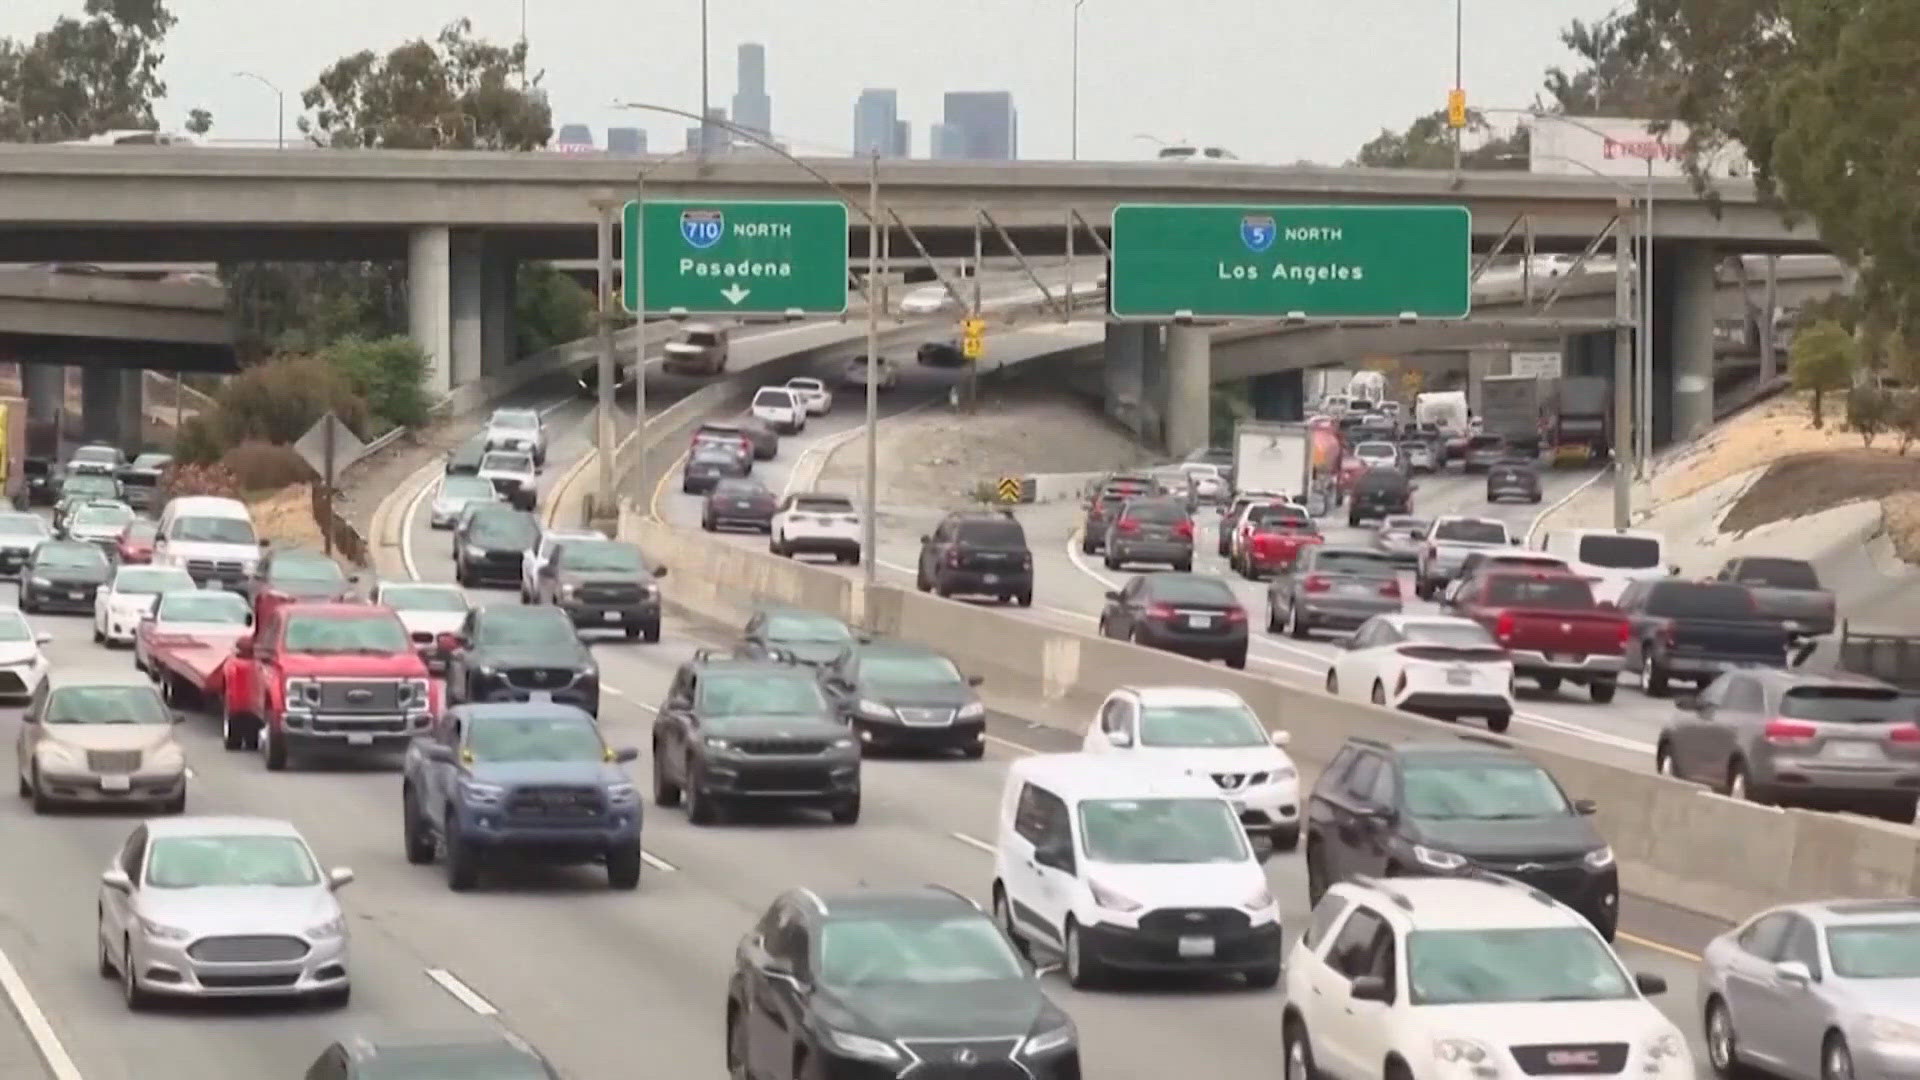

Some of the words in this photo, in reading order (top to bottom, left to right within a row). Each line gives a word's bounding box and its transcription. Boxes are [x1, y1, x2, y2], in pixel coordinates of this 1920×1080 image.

[686, 222, 719, 239] 710
[733, 223, 792, 238] NORTH
[1252, 227, 1265, 244] 5
[1285, 227, 1343, 241] NORTH
[679, 257, 791, 277] Pasadena
[1218, 261, 1259, 280] Los
[1272, 263, 1364, 285] Angeles
